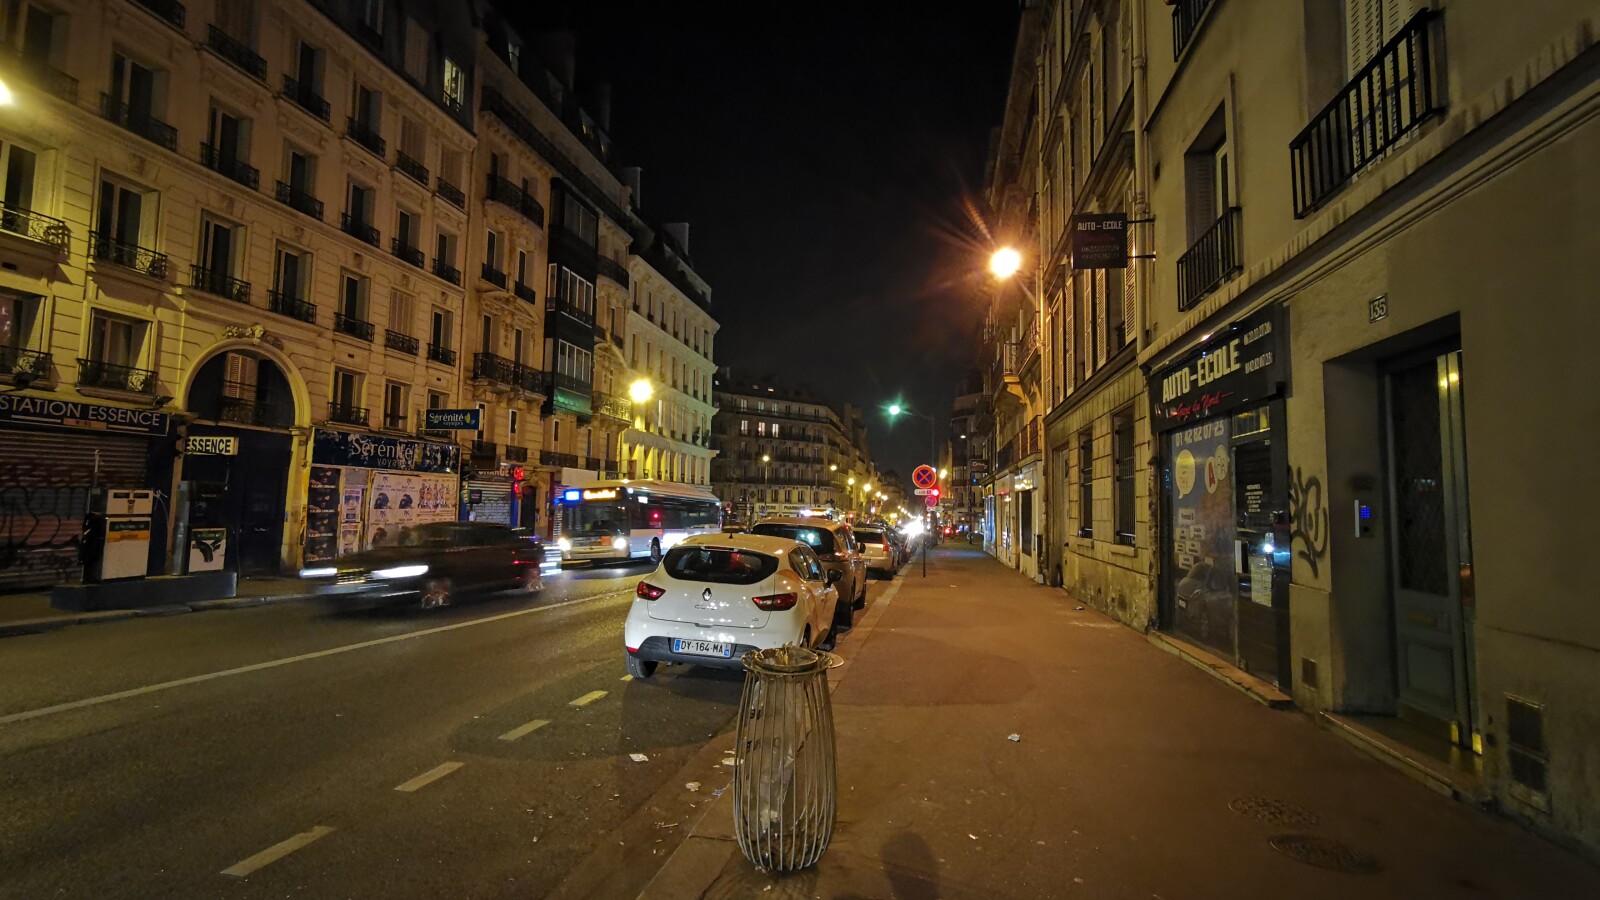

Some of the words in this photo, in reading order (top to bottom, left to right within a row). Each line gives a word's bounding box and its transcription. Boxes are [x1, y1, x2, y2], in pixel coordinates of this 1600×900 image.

[1370, 298, 1386, 320] 135
[1163, 338, 1241, 404] AUTO-ECOLE
[0, 394, 81, 418] STATION
[88, 405, 160, 426] ESSENCE
[680, 640, 724, 654] DY-164-MA
